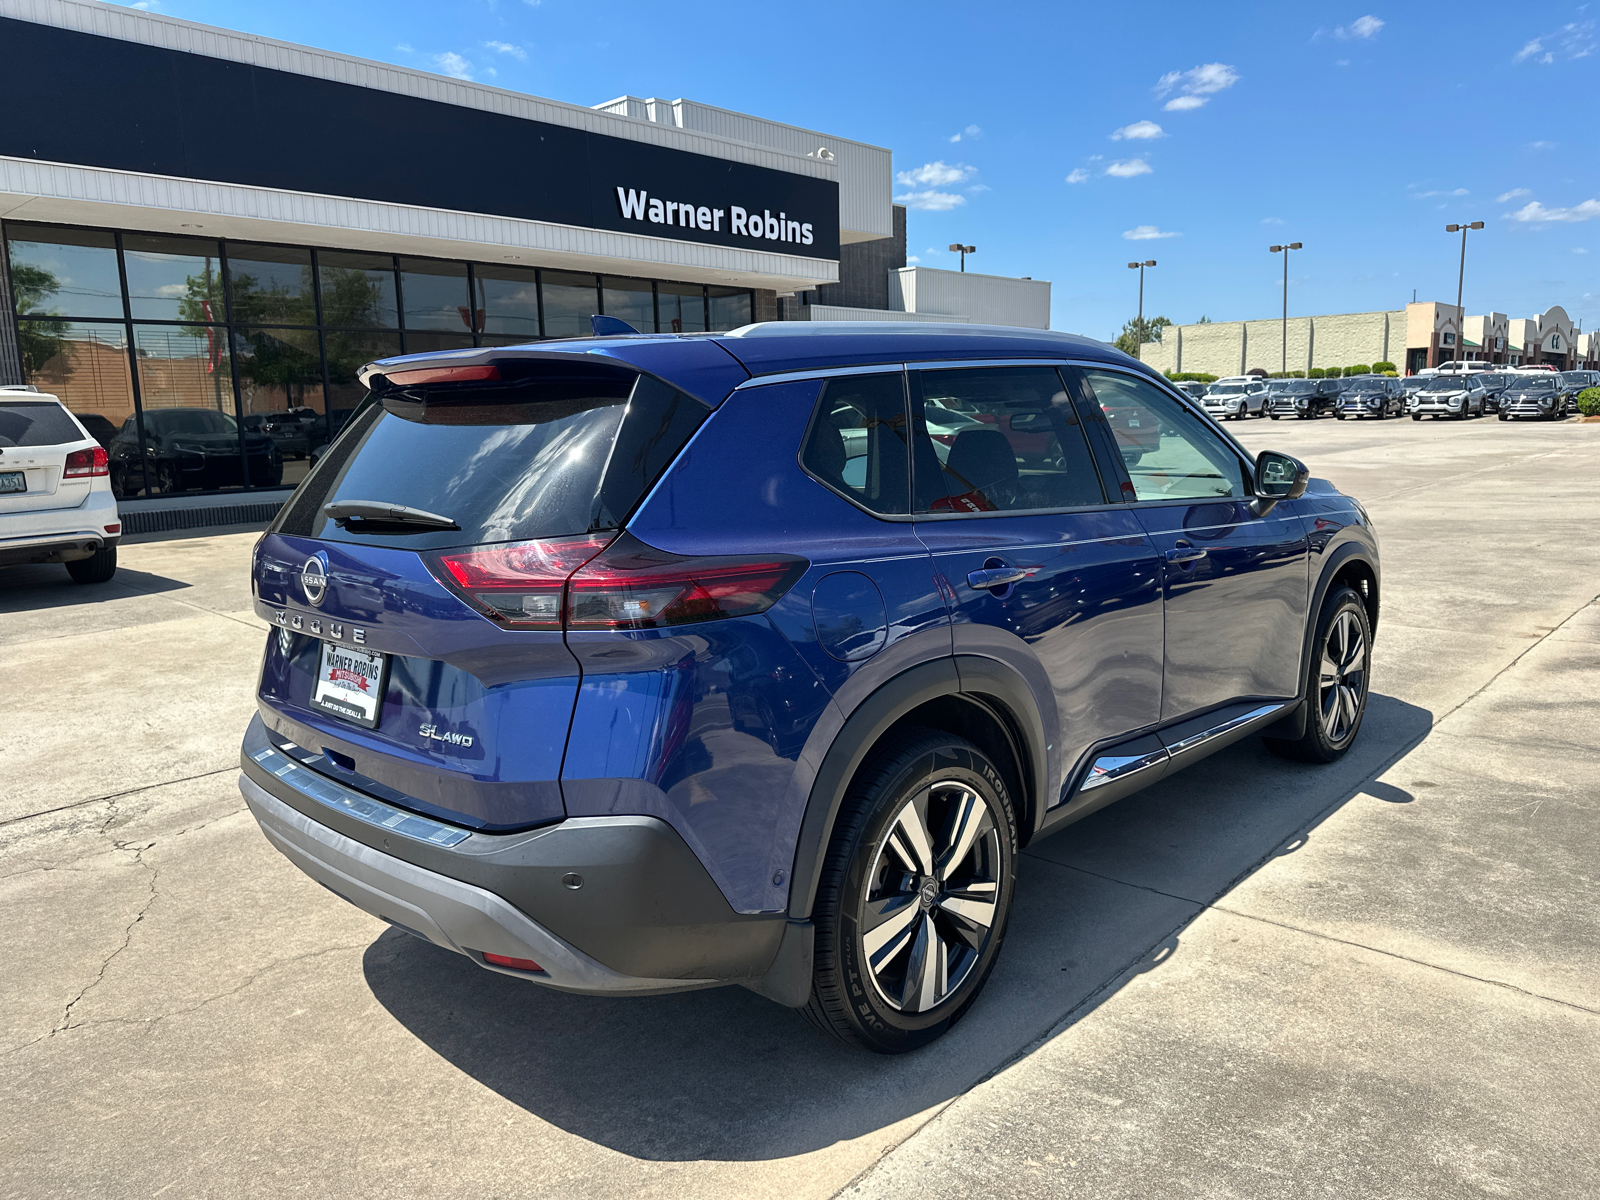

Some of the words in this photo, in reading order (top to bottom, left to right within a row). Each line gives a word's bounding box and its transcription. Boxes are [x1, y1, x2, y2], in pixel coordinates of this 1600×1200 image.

[616, 186, 724, 232] Warner
[730, 205, 814, 245] Robins
[276, 611, 366, 644] ROGUE
[326, 651, 353, 671] WARNER
[353, 659, 379, 681] ROBINS
[442, 731, 474, 748] AWD
[982, 764, 1017, 855] IRONMAN
[849, 969, 862, 997] PT
